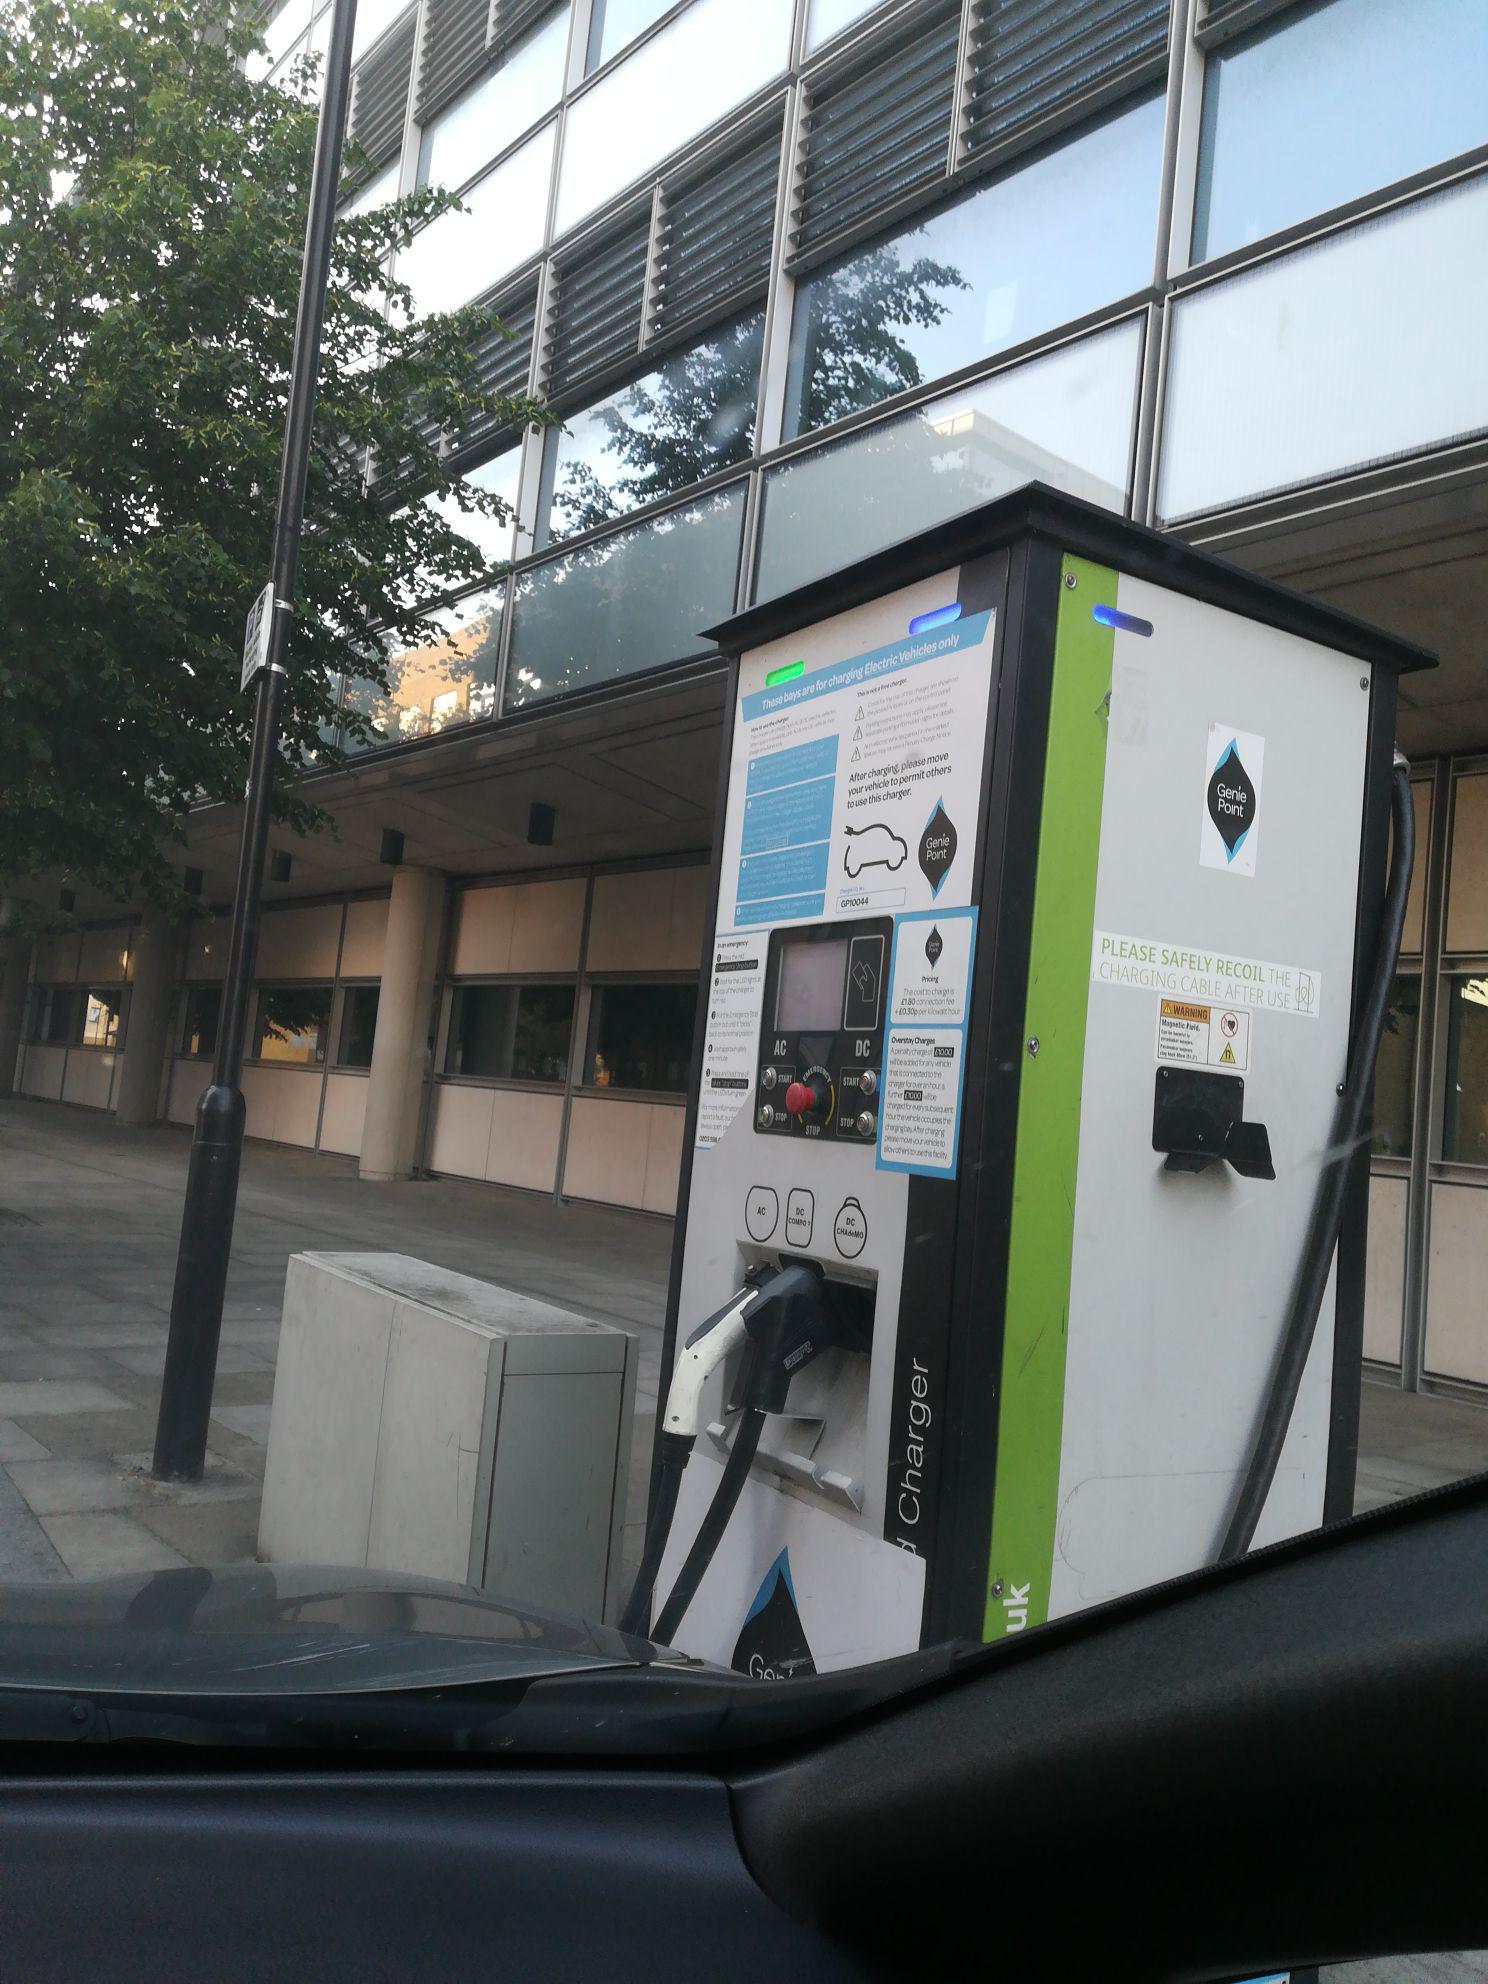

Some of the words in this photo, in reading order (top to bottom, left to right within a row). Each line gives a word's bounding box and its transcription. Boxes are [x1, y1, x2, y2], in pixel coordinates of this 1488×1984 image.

[762, 696, 783, 710] These
[784, 690, 801, 703] bays
[802, 684, 814, 695] are
[815, 679, 827, 690] for
[828, 667, 863, 686] charging
[865, 655, 898, 675] Electric
[899, 643, 937, 665] Vehicles
[938, 633, 960, 649] only
[849, 771, 867, 783] After
[867, 764, 900, 779] charging,
[900, 759, 926, 774] please
[926, 752, 949, 764] move
[848, 786, 864, 797] your
[864, 778, 890, 791] vehicle
[890, 777, 899, 786] to
[899, 770, 924, 787] permit
[926, 765, 952, 779] others
[847, 800, 854, 809] to
[855, 797, 867, 807] use
[868, 792, 881, 805] this
[882, 787, 912, 802] charger.
[1217, 783, 1247, 803] Genie
[1218, 798, 1244, 818] Point
[926, 833, 950, 849] Genie
[926, 849, 947, 860] Point
[841, 897, 869, 908] GP10044
[1102, 938, 1157, 963] PLEASE
[1161, 949, 1212, 973] SAFELY
[1216, 959, 1264, 982] RECOIL
[1268, 968, 1291, 987] THE
[922, 976, 938, 984] Pricing
[1100, 962, 1176, 990] CHARGING
[1181, 975, 1221, 996] CABLE
[1225, 984, 1263, 1005] AFTER
[1268, 990, 1291, 1009] USE
[904, 988, 913, 996] The
[914, 988, 925, 996] cost
[932, 988, 948, 997] charge
[916, 998, 945, 1006] connection
[1173, 1004, 1207, 1020] WARNING
[1162, 1019, 1185, 1029] Magnetic
[892, 1036, 914, 1045] Overstay
[915, 1037, 935, 1046] Charges
[774, 1040, 787, 1056] AC
[855, 1040, 870, 1058] DC
[935, 1048, 952, 1056] £10.00
[778, 1074, 792, 1084] START
[802, 1065, 832, 1083] EMERGENCY
[843, 1077, 860, 1087] START
[775, 1112, 787, 1122] STOP
[840, 1117, 855, 1128] STOP
[805, 1124, 821, 1136] STOP
[757, 1207, 766, 1216] AC
[796, 1208, 804, 1216] DC
[846, 1217, 856, 1226] DC
[836, 1227, 864, 1239] CHAdeMO
[898, 1357, 932, 1525] Charger
